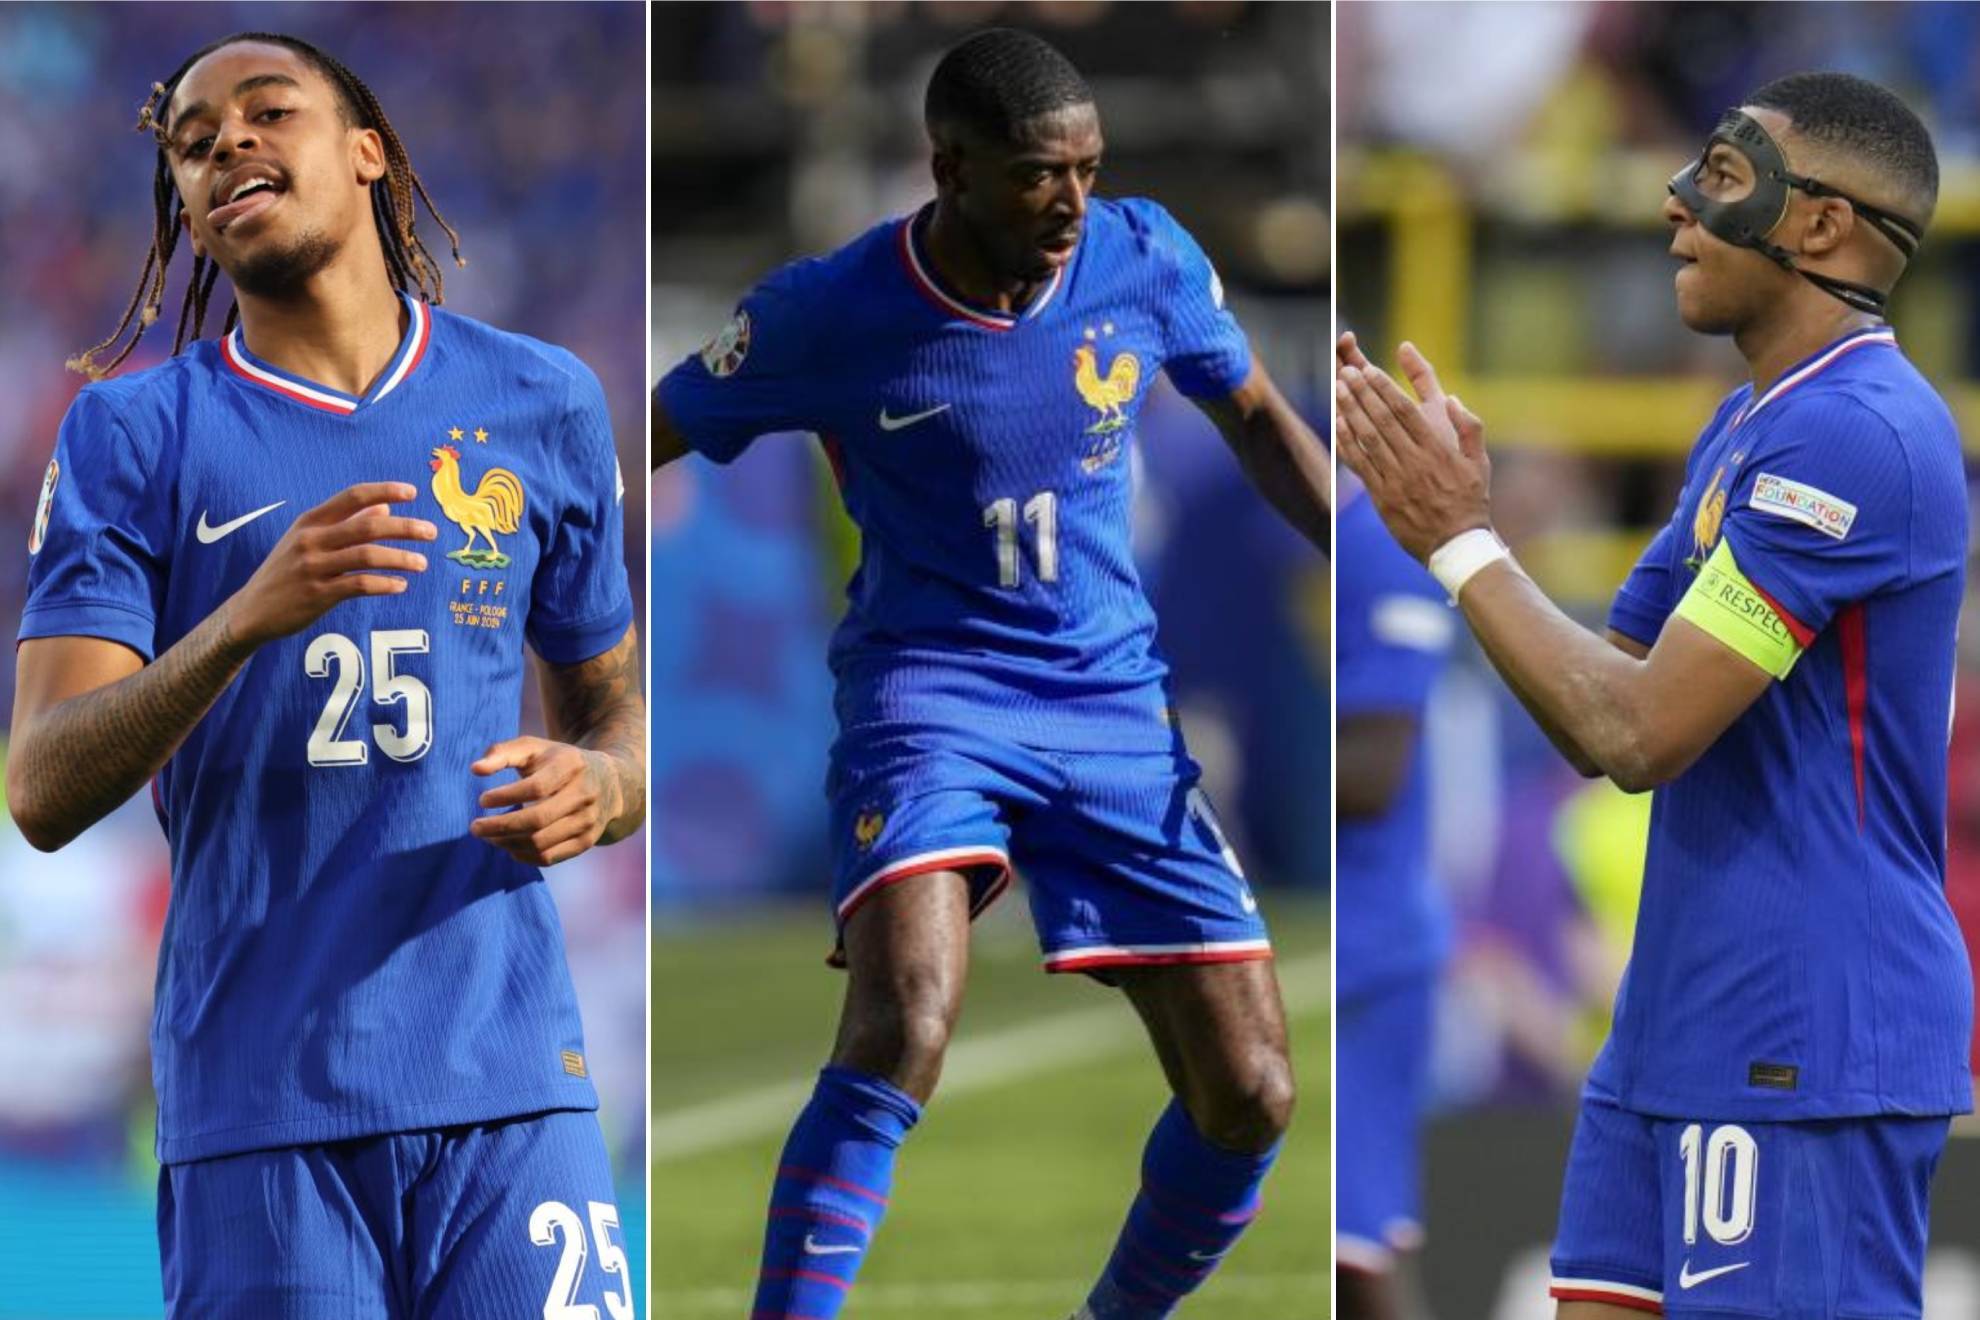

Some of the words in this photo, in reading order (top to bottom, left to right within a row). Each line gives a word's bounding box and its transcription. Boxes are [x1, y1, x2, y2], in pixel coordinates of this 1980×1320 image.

[984, 491, 1058, 588] 11
[1756, 483, 1851, 528] FOUNDATION
[305, 629, 433, 767] 25
[1680, 1124, 1758, 1246] 10
[529, 1201, 634, 1320] 25
